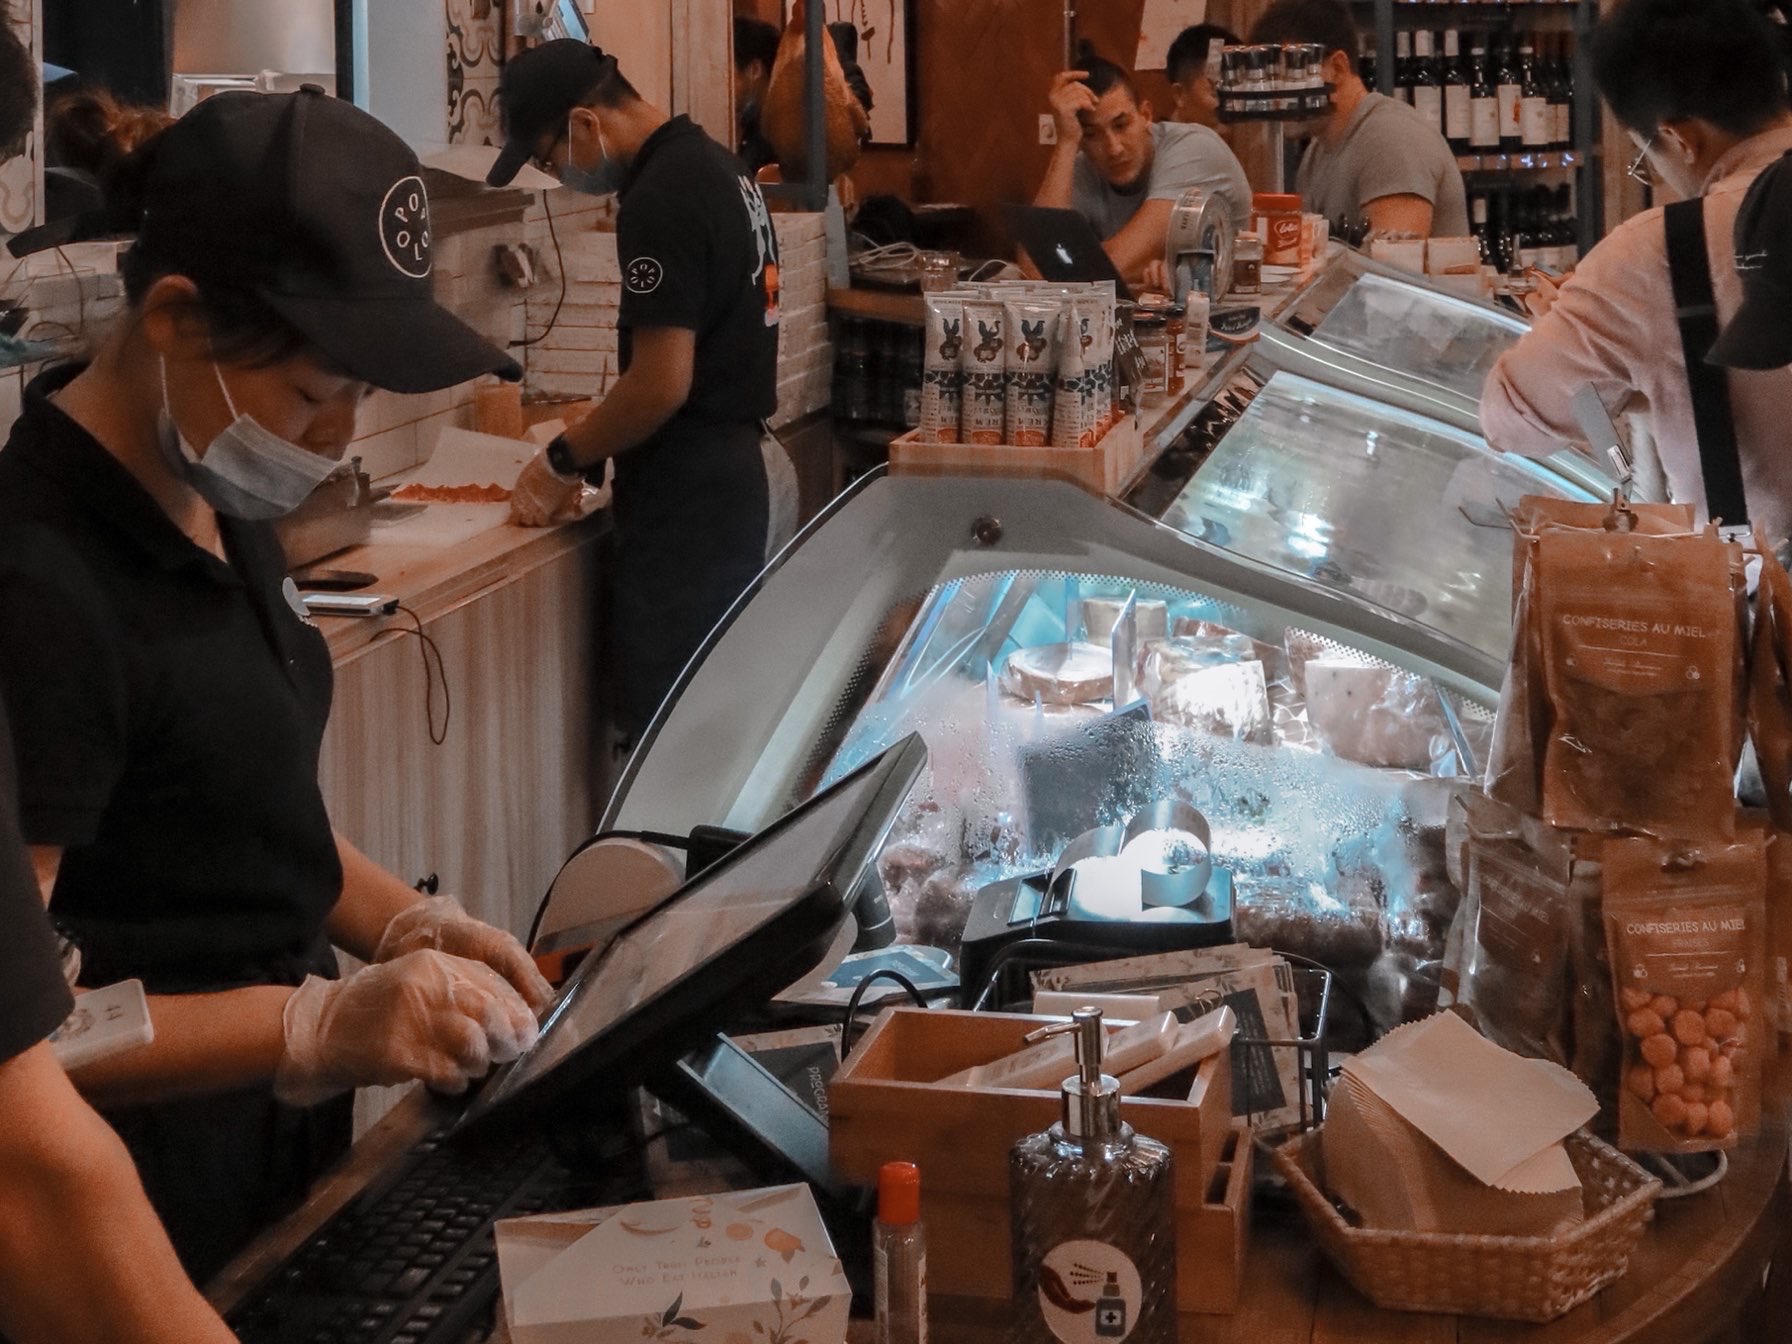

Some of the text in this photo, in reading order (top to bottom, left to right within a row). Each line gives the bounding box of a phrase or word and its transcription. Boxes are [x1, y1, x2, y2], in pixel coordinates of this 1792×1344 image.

[1562, 614, 1706, 639] CONFISERIES AU MIEL
[1626, 921, 1699, 935] CONFISERIES
[1702, 921, 1717, 932] AU
